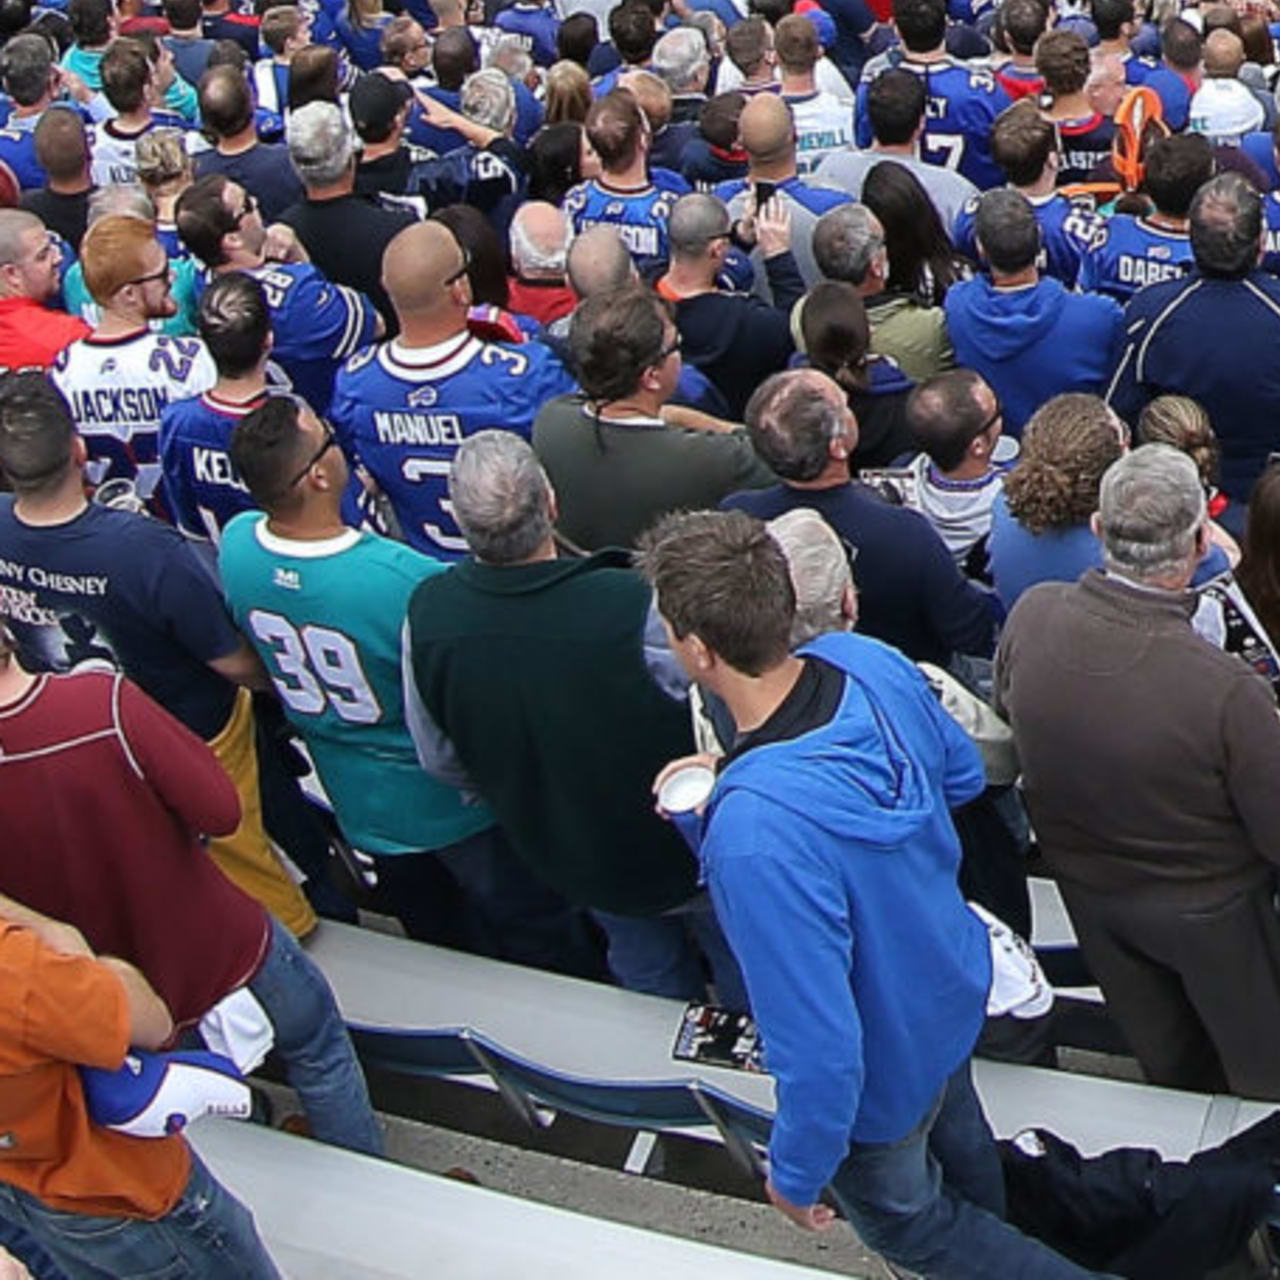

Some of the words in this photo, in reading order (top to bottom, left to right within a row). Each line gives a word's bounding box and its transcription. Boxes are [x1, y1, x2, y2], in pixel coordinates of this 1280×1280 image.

[69, 386, 168, 427] JACKSON
[373, 411, 465, 445] MANUEL
[28, 567, 109, 595] CHESNEY
[249, 607, 383, 725] 39
